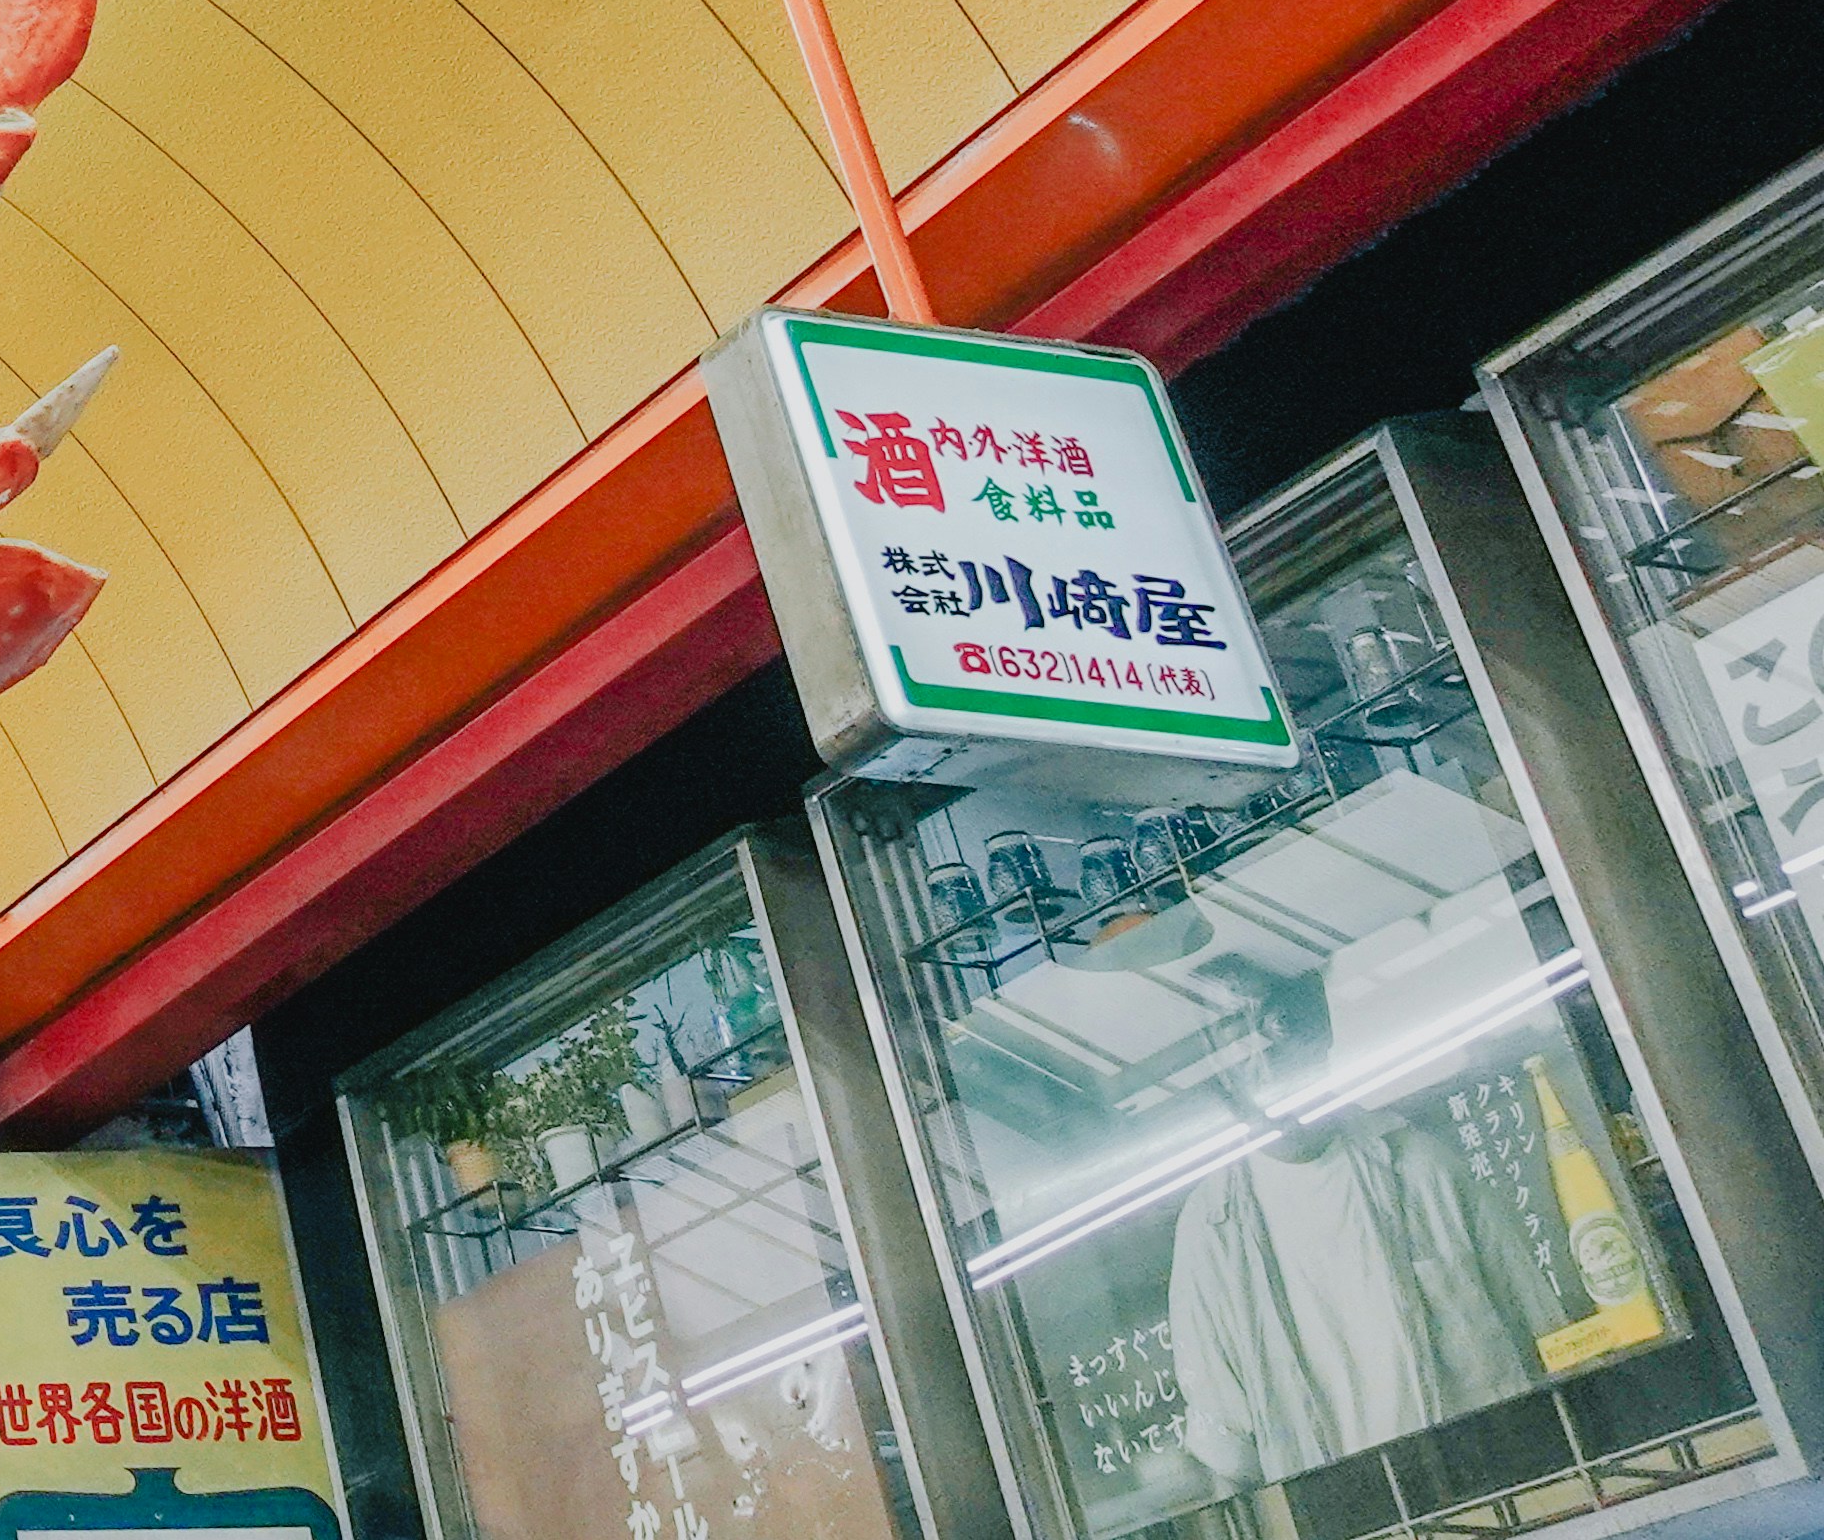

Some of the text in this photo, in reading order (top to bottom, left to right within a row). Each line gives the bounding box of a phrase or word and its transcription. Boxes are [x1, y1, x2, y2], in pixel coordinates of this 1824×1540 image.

[834, 408, 945, 513] 酒
[972, 476, 1116, 530] 食料品
[882, 546, 955, 580] 株式
[892, 585, 970, 617] 会社
[1498, 1074, 1535, 1154] キリン
[1476, 1083, 1562, 1297] クラシックラガー
[62, 1277, 269, 1346] 売る店
